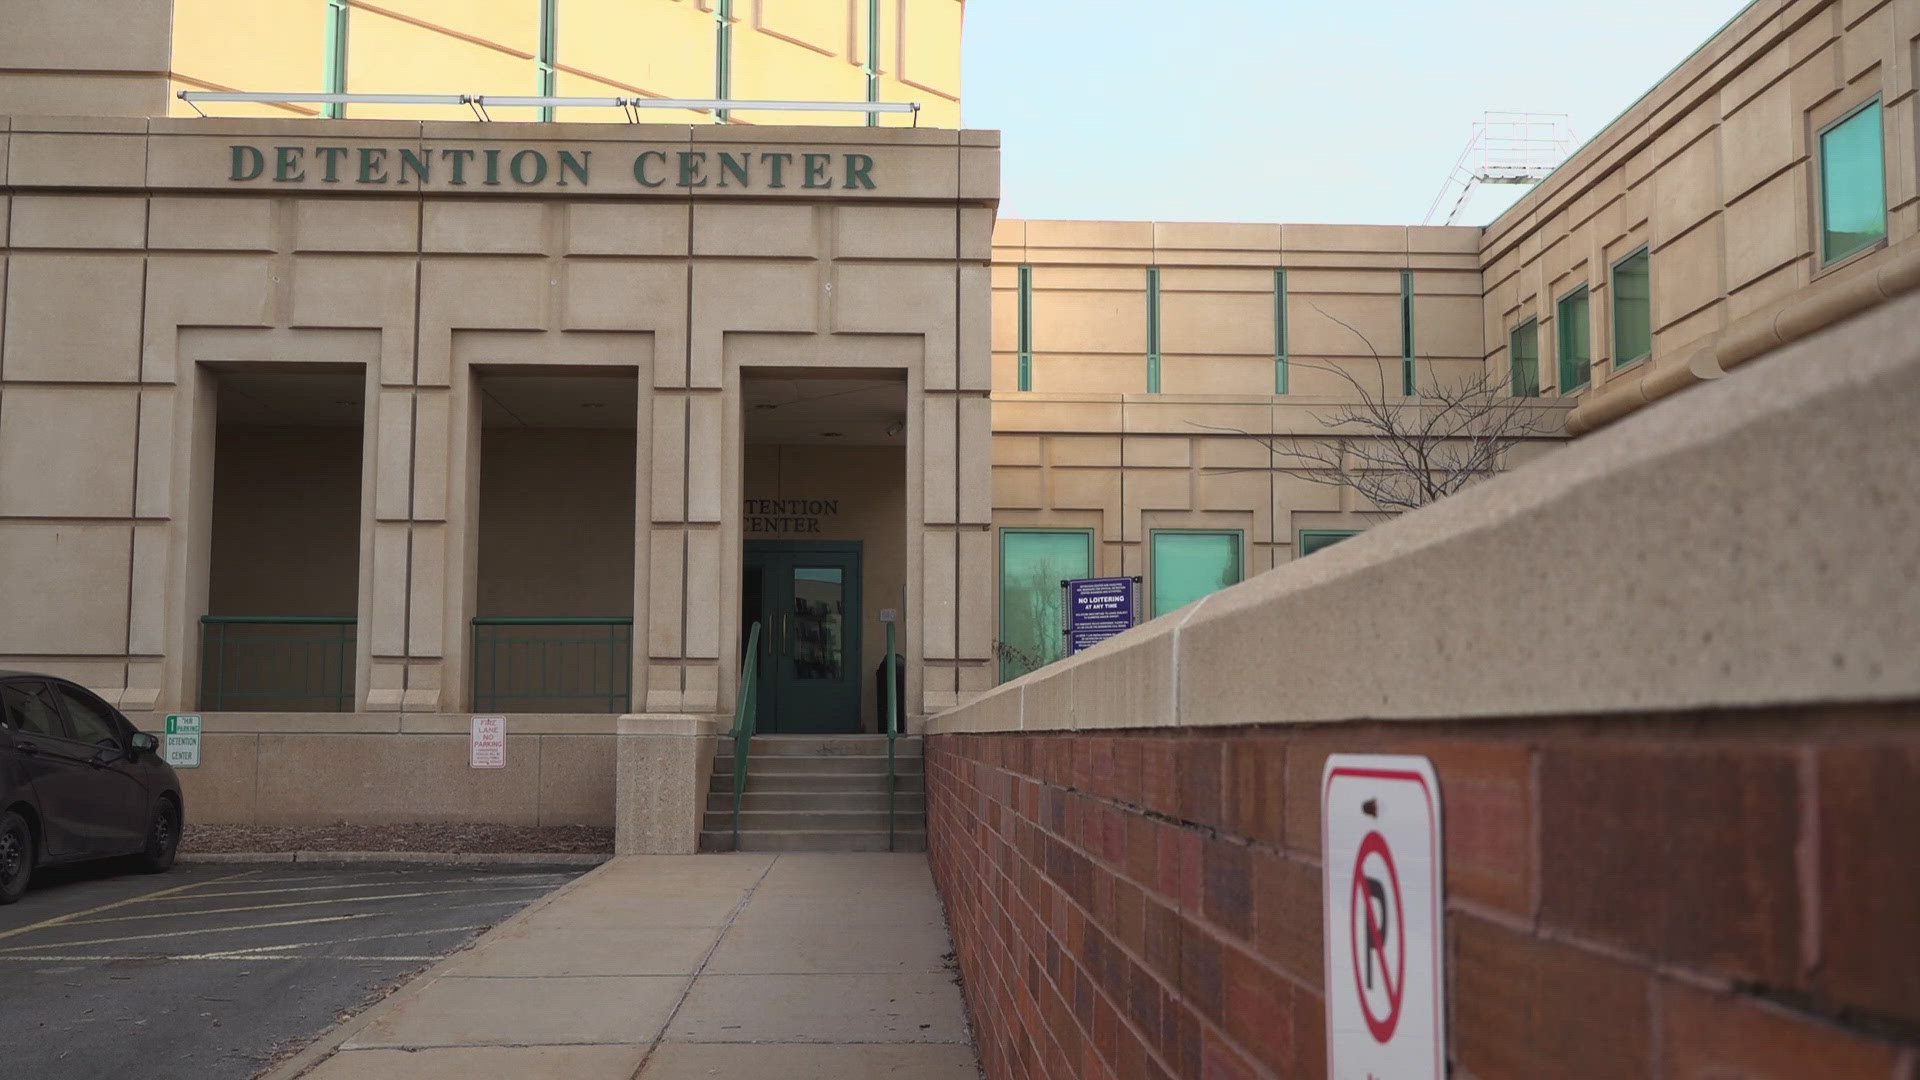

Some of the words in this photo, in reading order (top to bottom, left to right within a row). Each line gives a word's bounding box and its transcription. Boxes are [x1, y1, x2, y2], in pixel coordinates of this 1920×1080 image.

[229, 144, 591, 187] DETENTION
[633, 149, 876, 191] CENTER
[1089, 595, 1125, 604] LOITERING
[168, 737, 197, 746] DETENTION
[171, 752, 193, 761] CENTER
